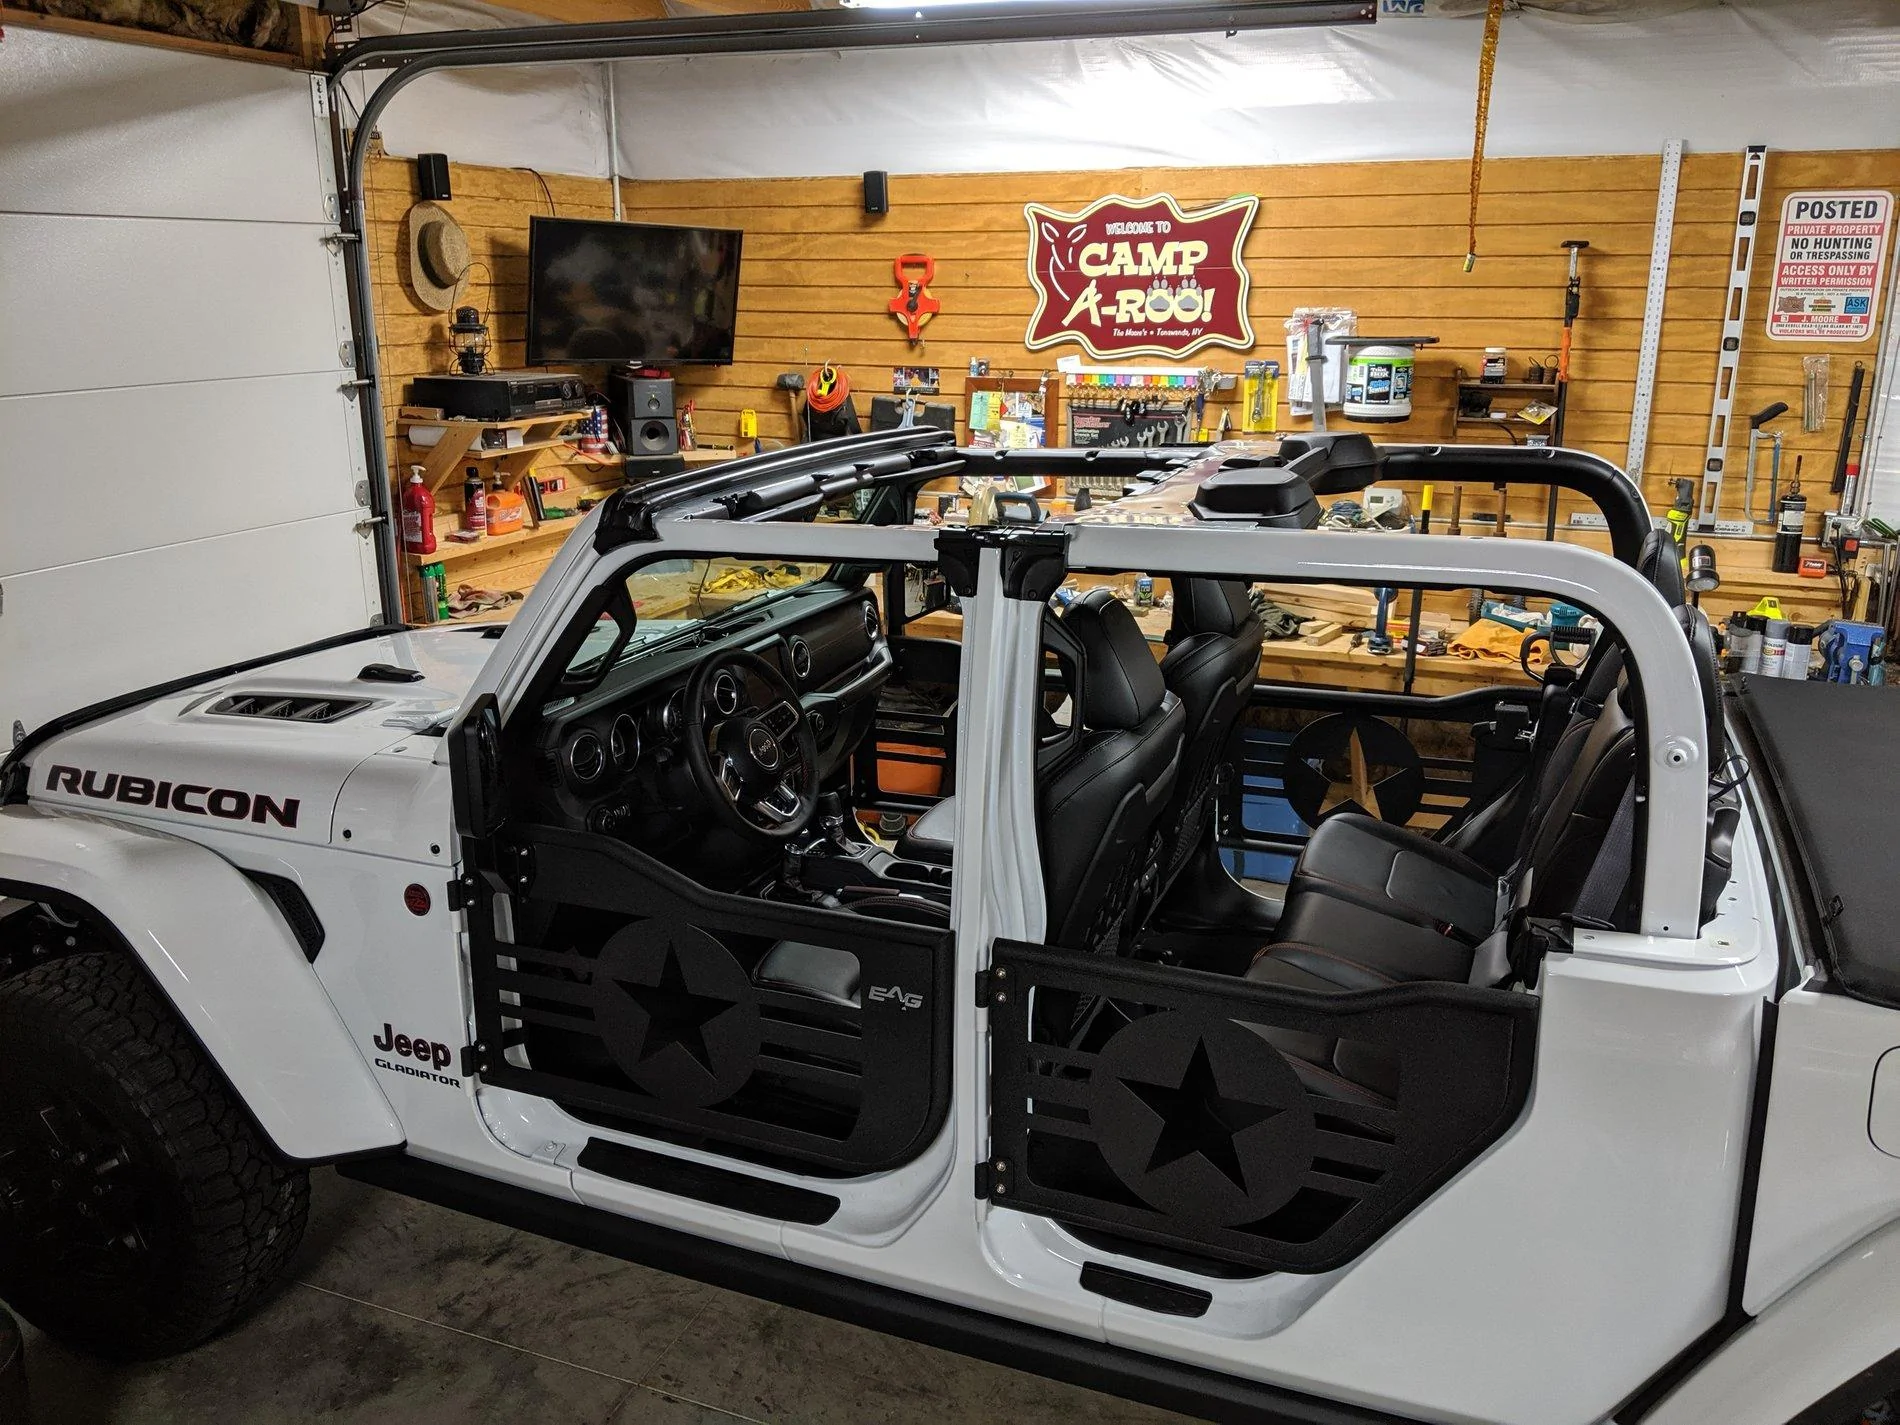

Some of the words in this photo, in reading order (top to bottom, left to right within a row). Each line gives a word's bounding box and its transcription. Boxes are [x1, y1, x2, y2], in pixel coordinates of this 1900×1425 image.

[1795, 200, 1878, 220] POSTED
[1105, 220, 1154, 235] WELCOME
[1155, 220, 1172, 234] TO
[1787, 225, 1827, 235] PRIVATE
[1829, 224, 1881, 235] PROPERTY
[1790, 237, 1809, 250] NO
[1813, 237, 1873, 250] HUNTING
[1078, 240, 1208, 277] CAMP
[1789, 251, 1803, 260] OR
[1805, 251, 1870, 261] TRESPASSING
[1781, 265, 1825, 276] ACCESS
[1828, 265, 1857, 276] ONLY
[1858, 265, 1875, 276] BY
[1780, 277, 1818, 286] WRITTEN
[1819, 277, 1872, 287] PERMISSION
[1061, 277, 1216, 328] A-ROO!
[1847, 298, 1866, 307] ASK
[1800, 315, 1809, 323] J.
[1810, 315, 1839, 323] MOORE
[1112, 328, 1123, 337] The
[1125, 328, 1148, 337] Moore's
[1191, 327, 1204, 337] NY
[45, 764, 301, 829] RUBICON
[373, 1022, 452, 1072] Jeep
[374, 1057, 461, 1089] GLADIATOR
